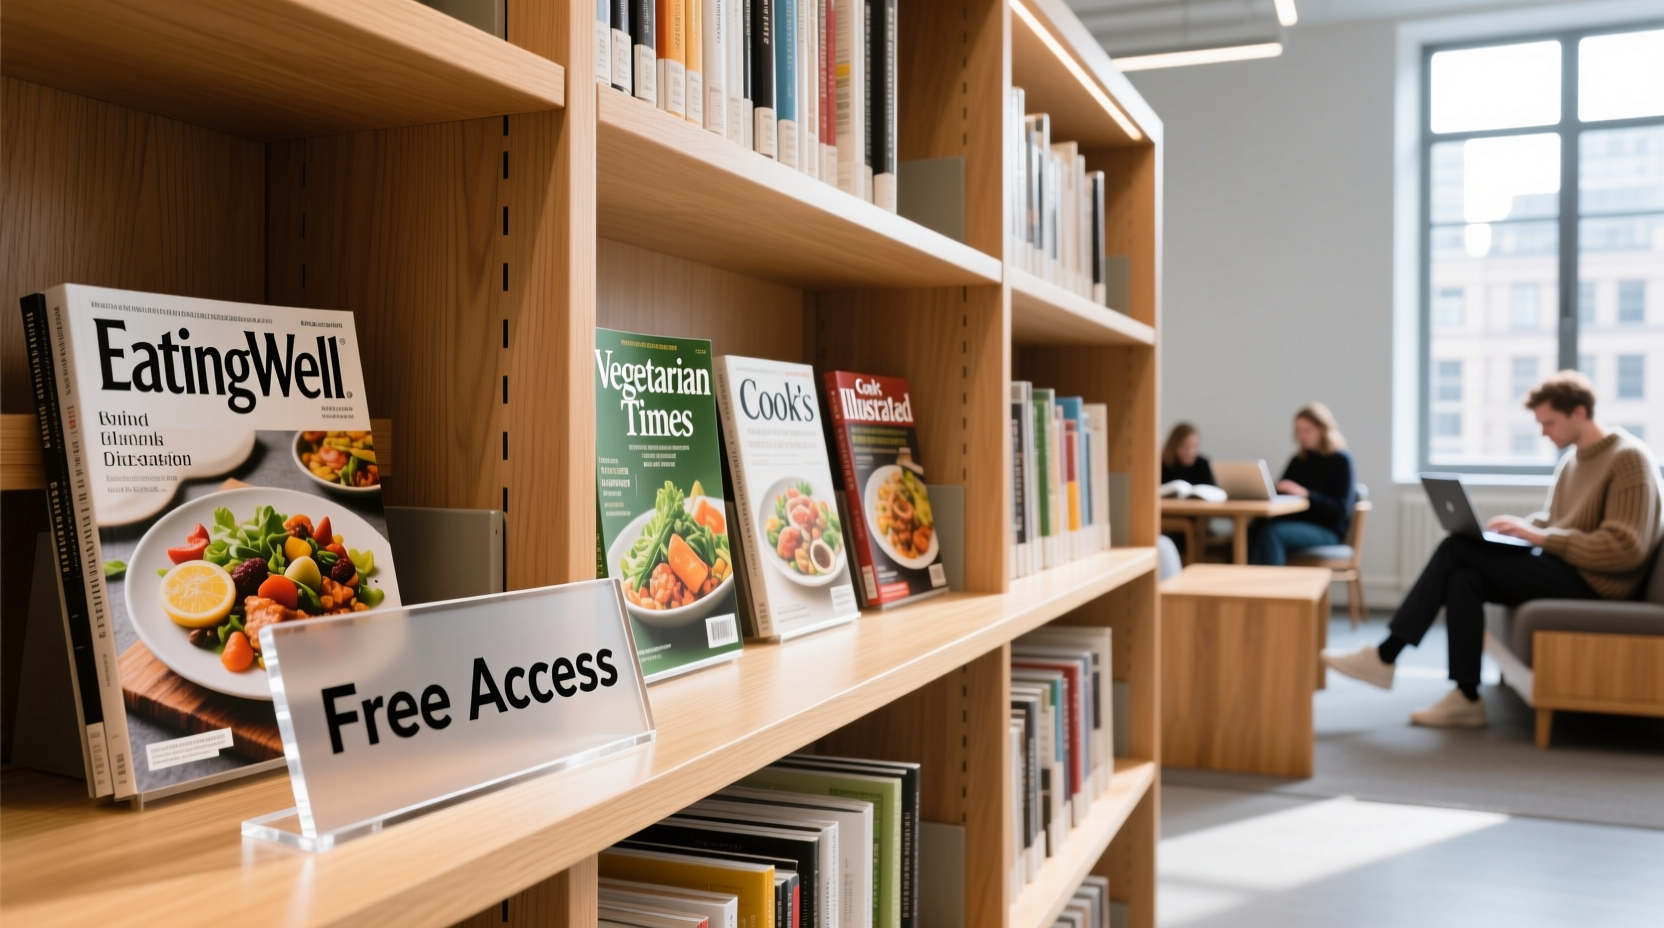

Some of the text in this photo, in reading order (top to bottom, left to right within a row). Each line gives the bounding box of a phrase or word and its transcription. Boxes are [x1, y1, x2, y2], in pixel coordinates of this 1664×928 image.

[93, 317, 346, 415] EatingWell
[594, 348, 712, 401] Vegetarian
[620, 399, 694, 438] Times
[739, 378, 815, 422] Cook's
[321, 648, 618, 755] Free Access
